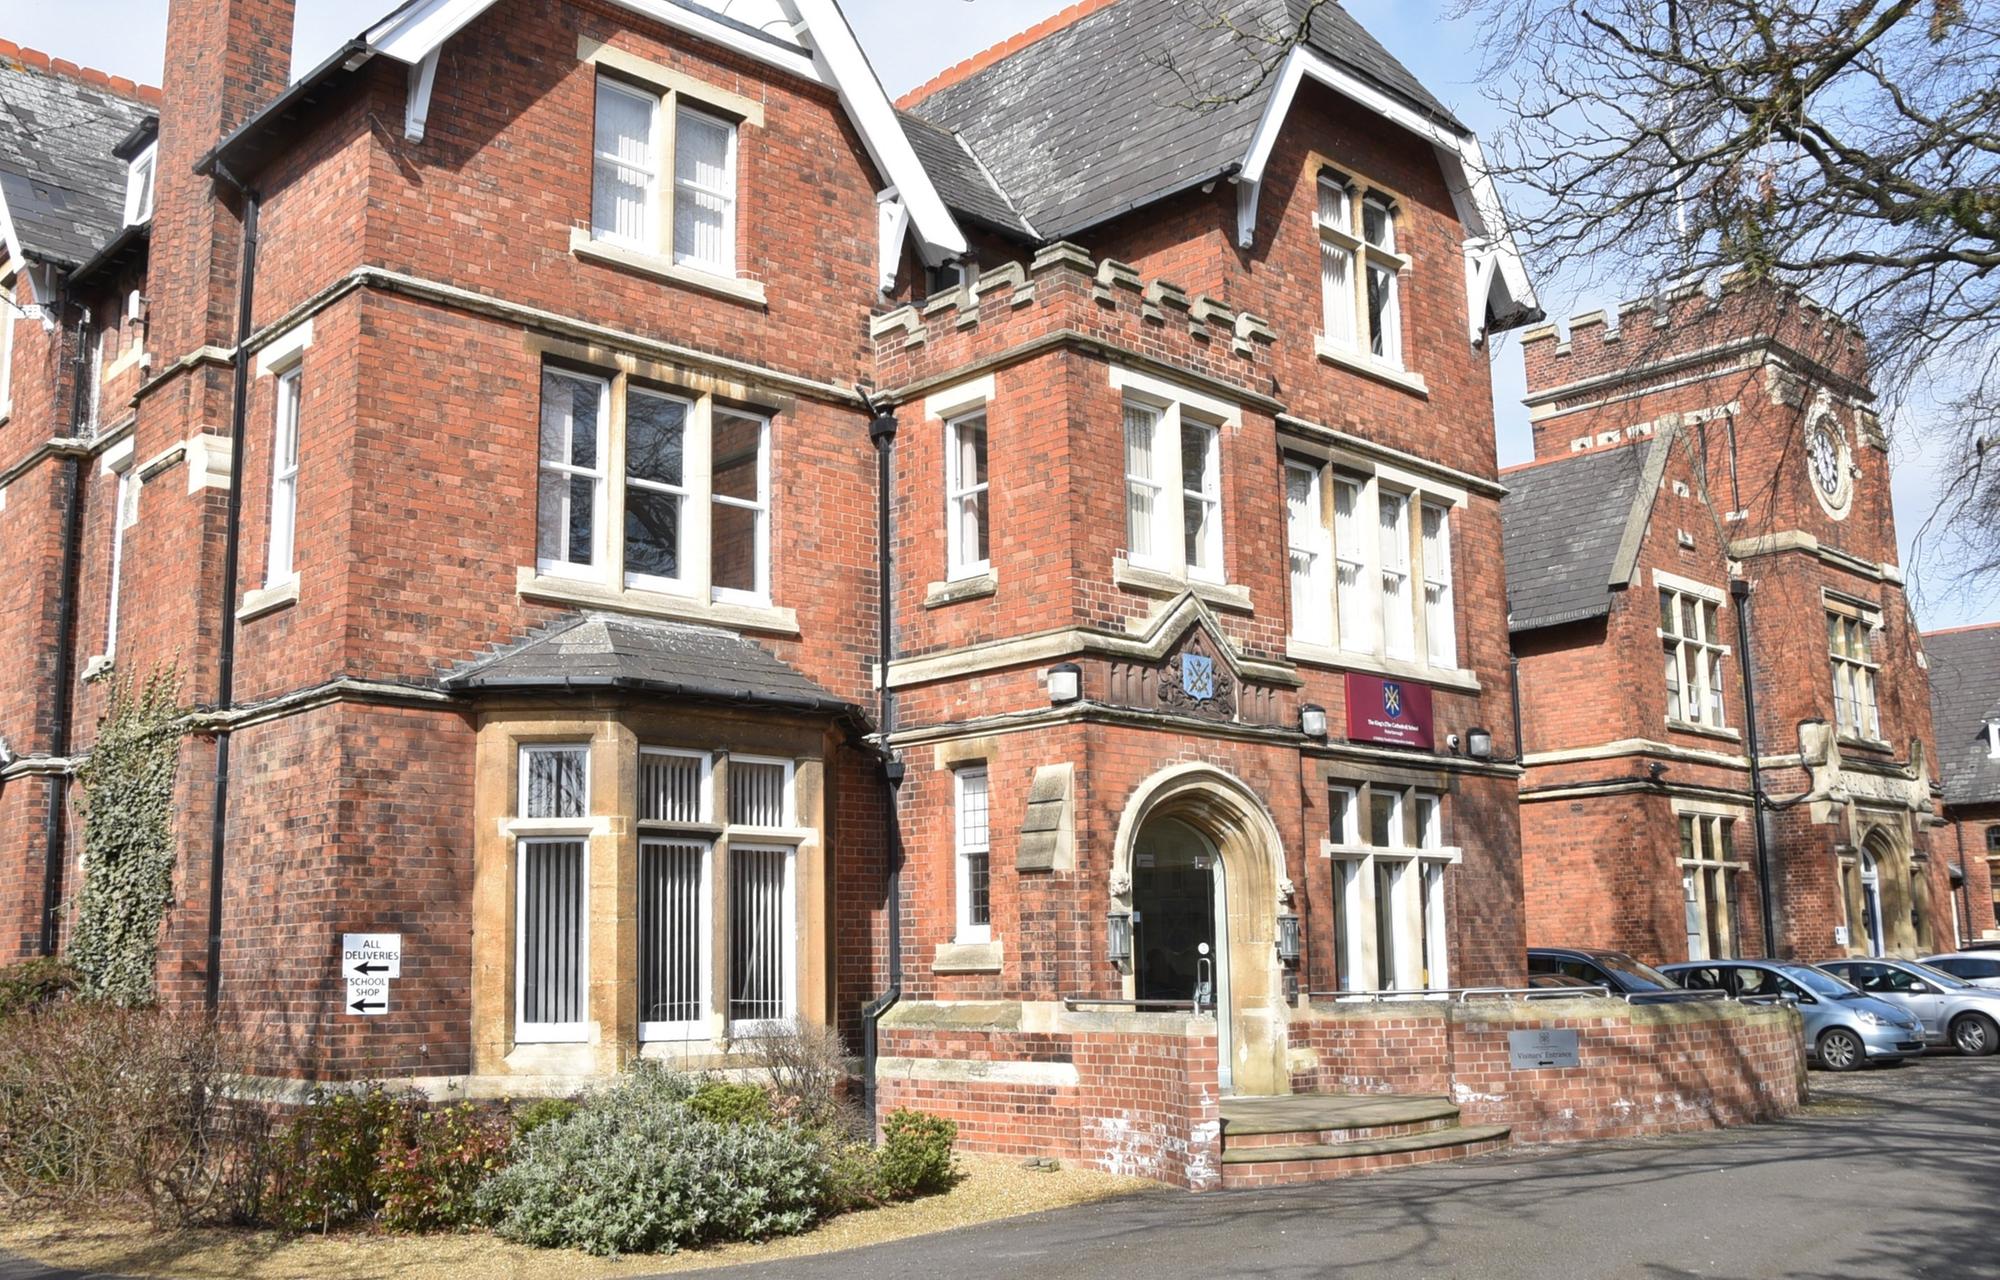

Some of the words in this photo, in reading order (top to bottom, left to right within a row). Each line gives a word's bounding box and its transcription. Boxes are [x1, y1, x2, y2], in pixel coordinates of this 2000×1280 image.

[363, 940, 380, 948] ALL
[345, 951, 399, 960] DELIVERIES
[350, 978, 386, 986] SCHOOL
[356, 988, 380, 996] SHOP
